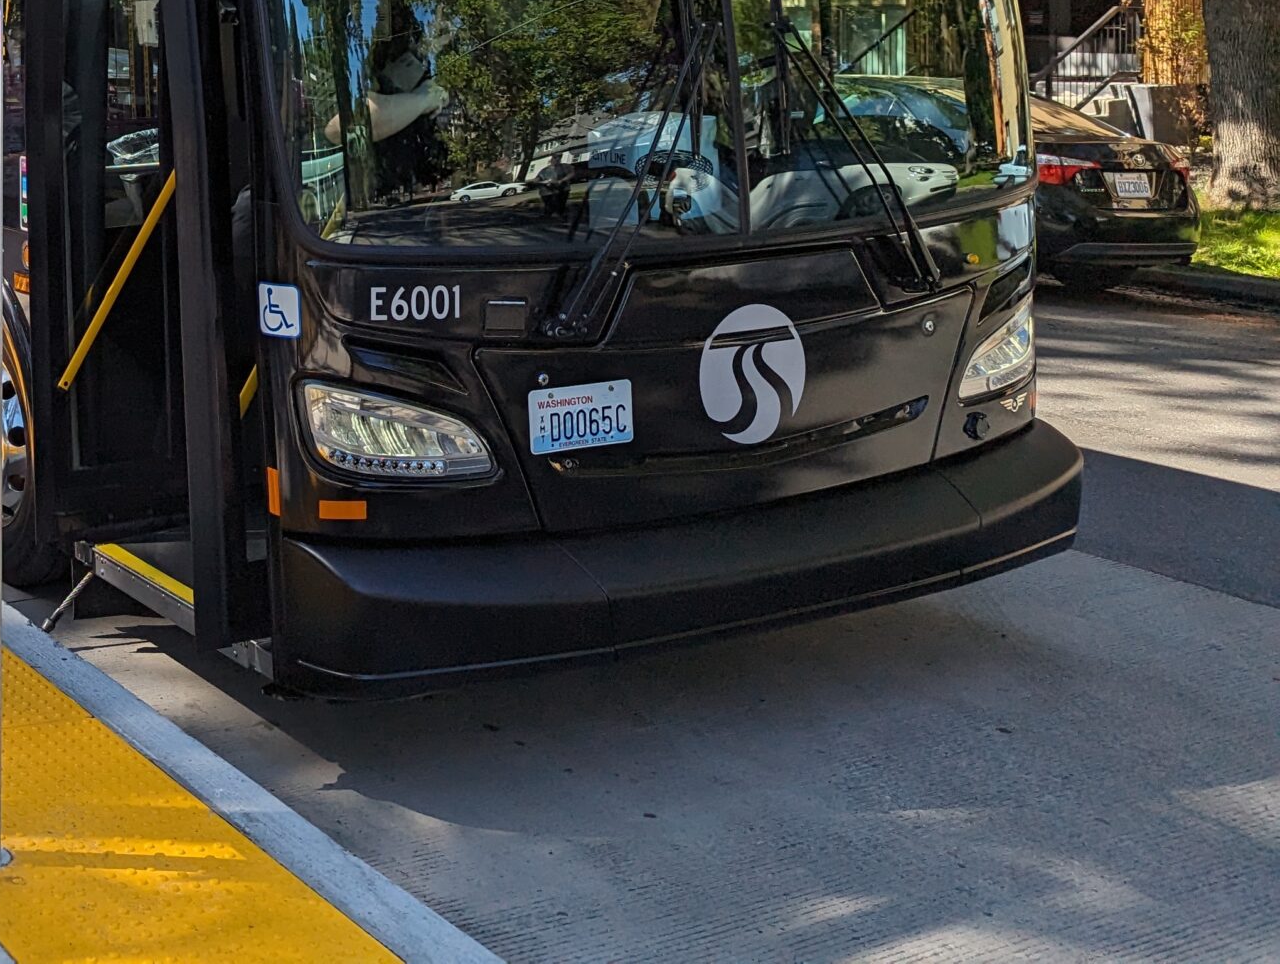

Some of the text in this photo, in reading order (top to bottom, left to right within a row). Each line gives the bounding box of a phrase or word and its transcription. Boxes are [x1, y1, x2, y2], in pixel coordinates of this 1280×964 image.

[370, 284, 460, 321] E6001
[537, 395, 593, 410] WASHINGTON
[550, 404, 627, 443] D0065C
[559, 436, 607, 448] EVERGREEN STATE
